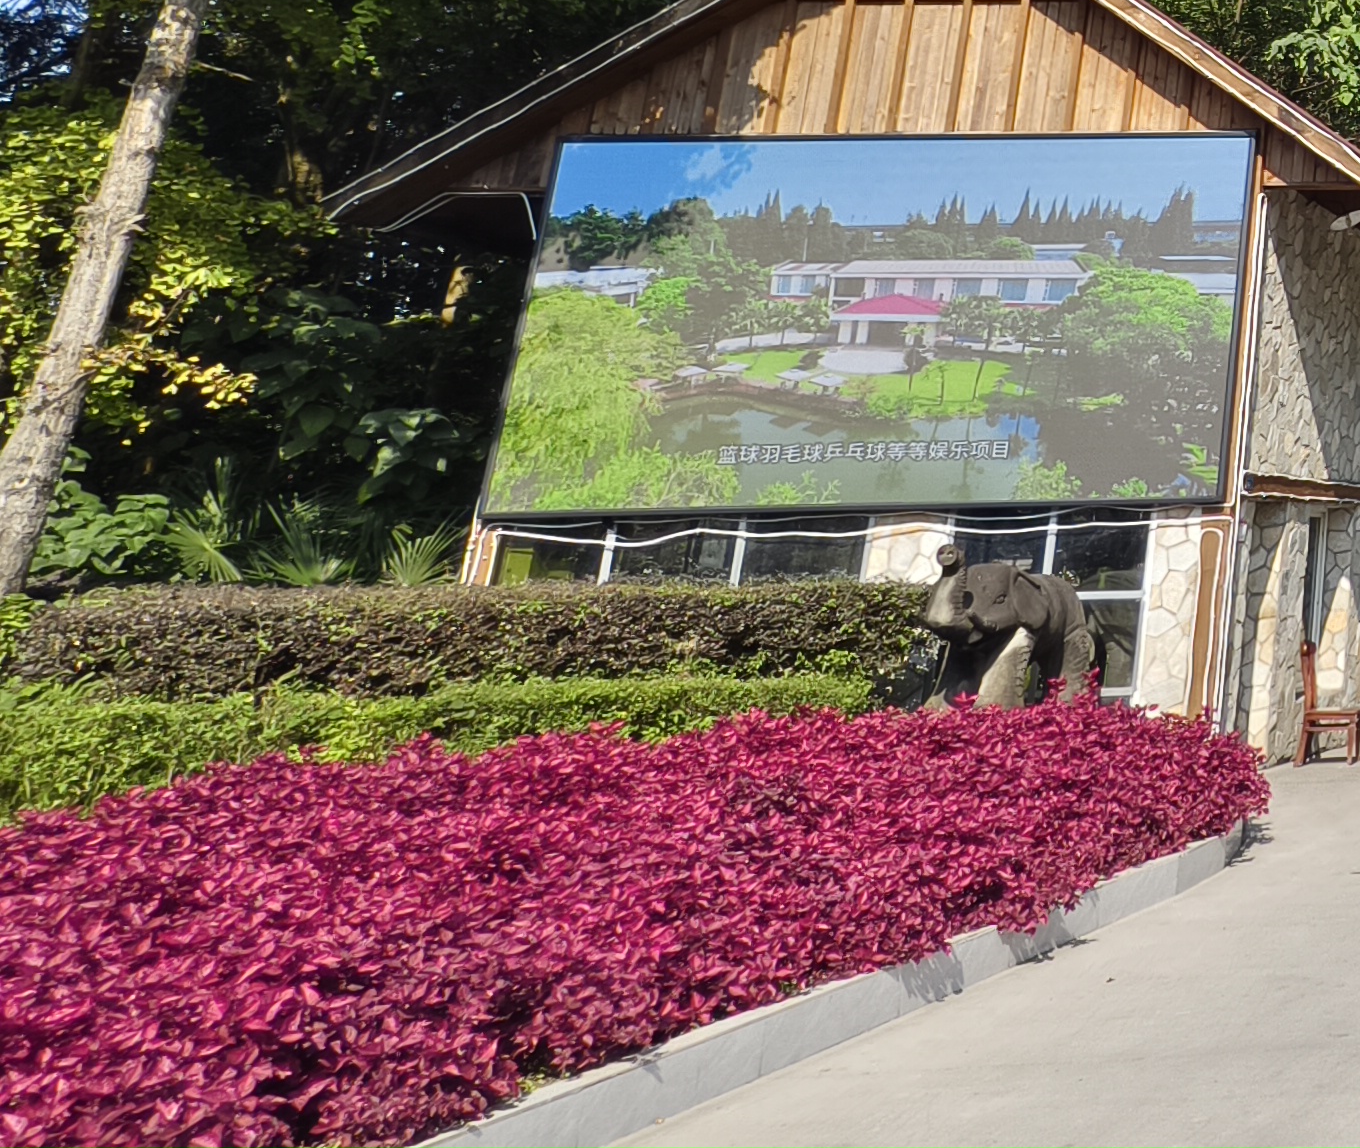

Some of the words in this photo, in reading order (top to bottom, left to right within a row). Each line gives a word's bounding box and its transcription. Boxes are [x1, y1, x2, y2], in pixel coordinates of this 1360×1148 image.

[717, 440, 1009, 465] 篮球羽毛球乒乓球等等娱乐项目
